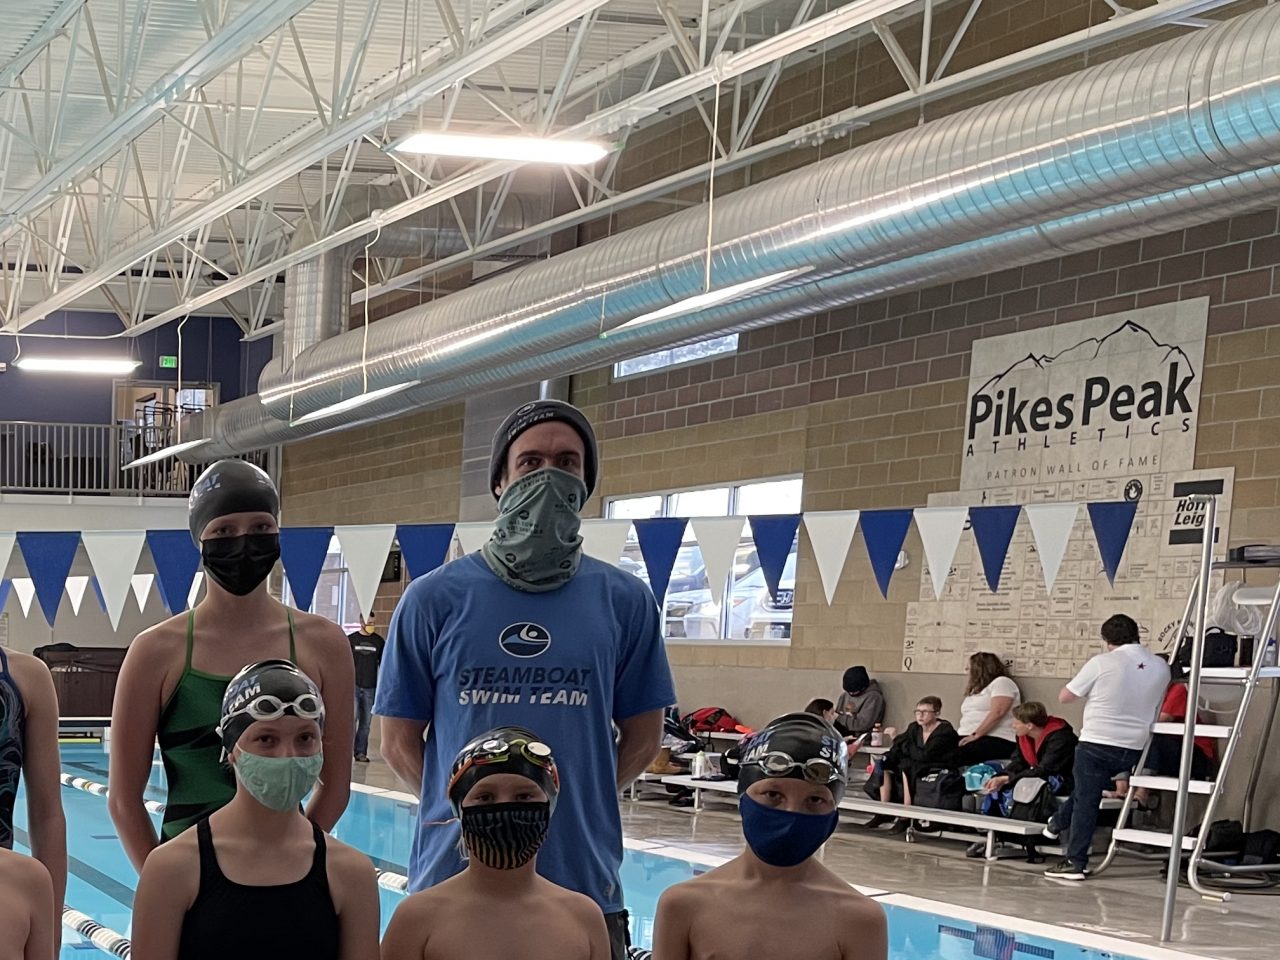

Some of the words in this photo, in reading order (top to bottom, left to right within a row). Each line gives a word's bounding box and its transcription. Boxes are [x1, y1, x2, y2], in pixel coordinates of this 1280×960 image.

[966, 418, 1190, 457] ATHLETICS
[986, 466, 1037, 481] PATRON
[1047, 463, 1081, 475] WALL
[1091, 459, 1108, 471] OF
[1119, 455, 1159, 469] FAME
[1174, 512, 1205, 527] Leig
[459, 667, 591, 686] STEAMBOAT
[459, 687, 520, 705] SWIM
[528, 687, 589, 707] TEAM
